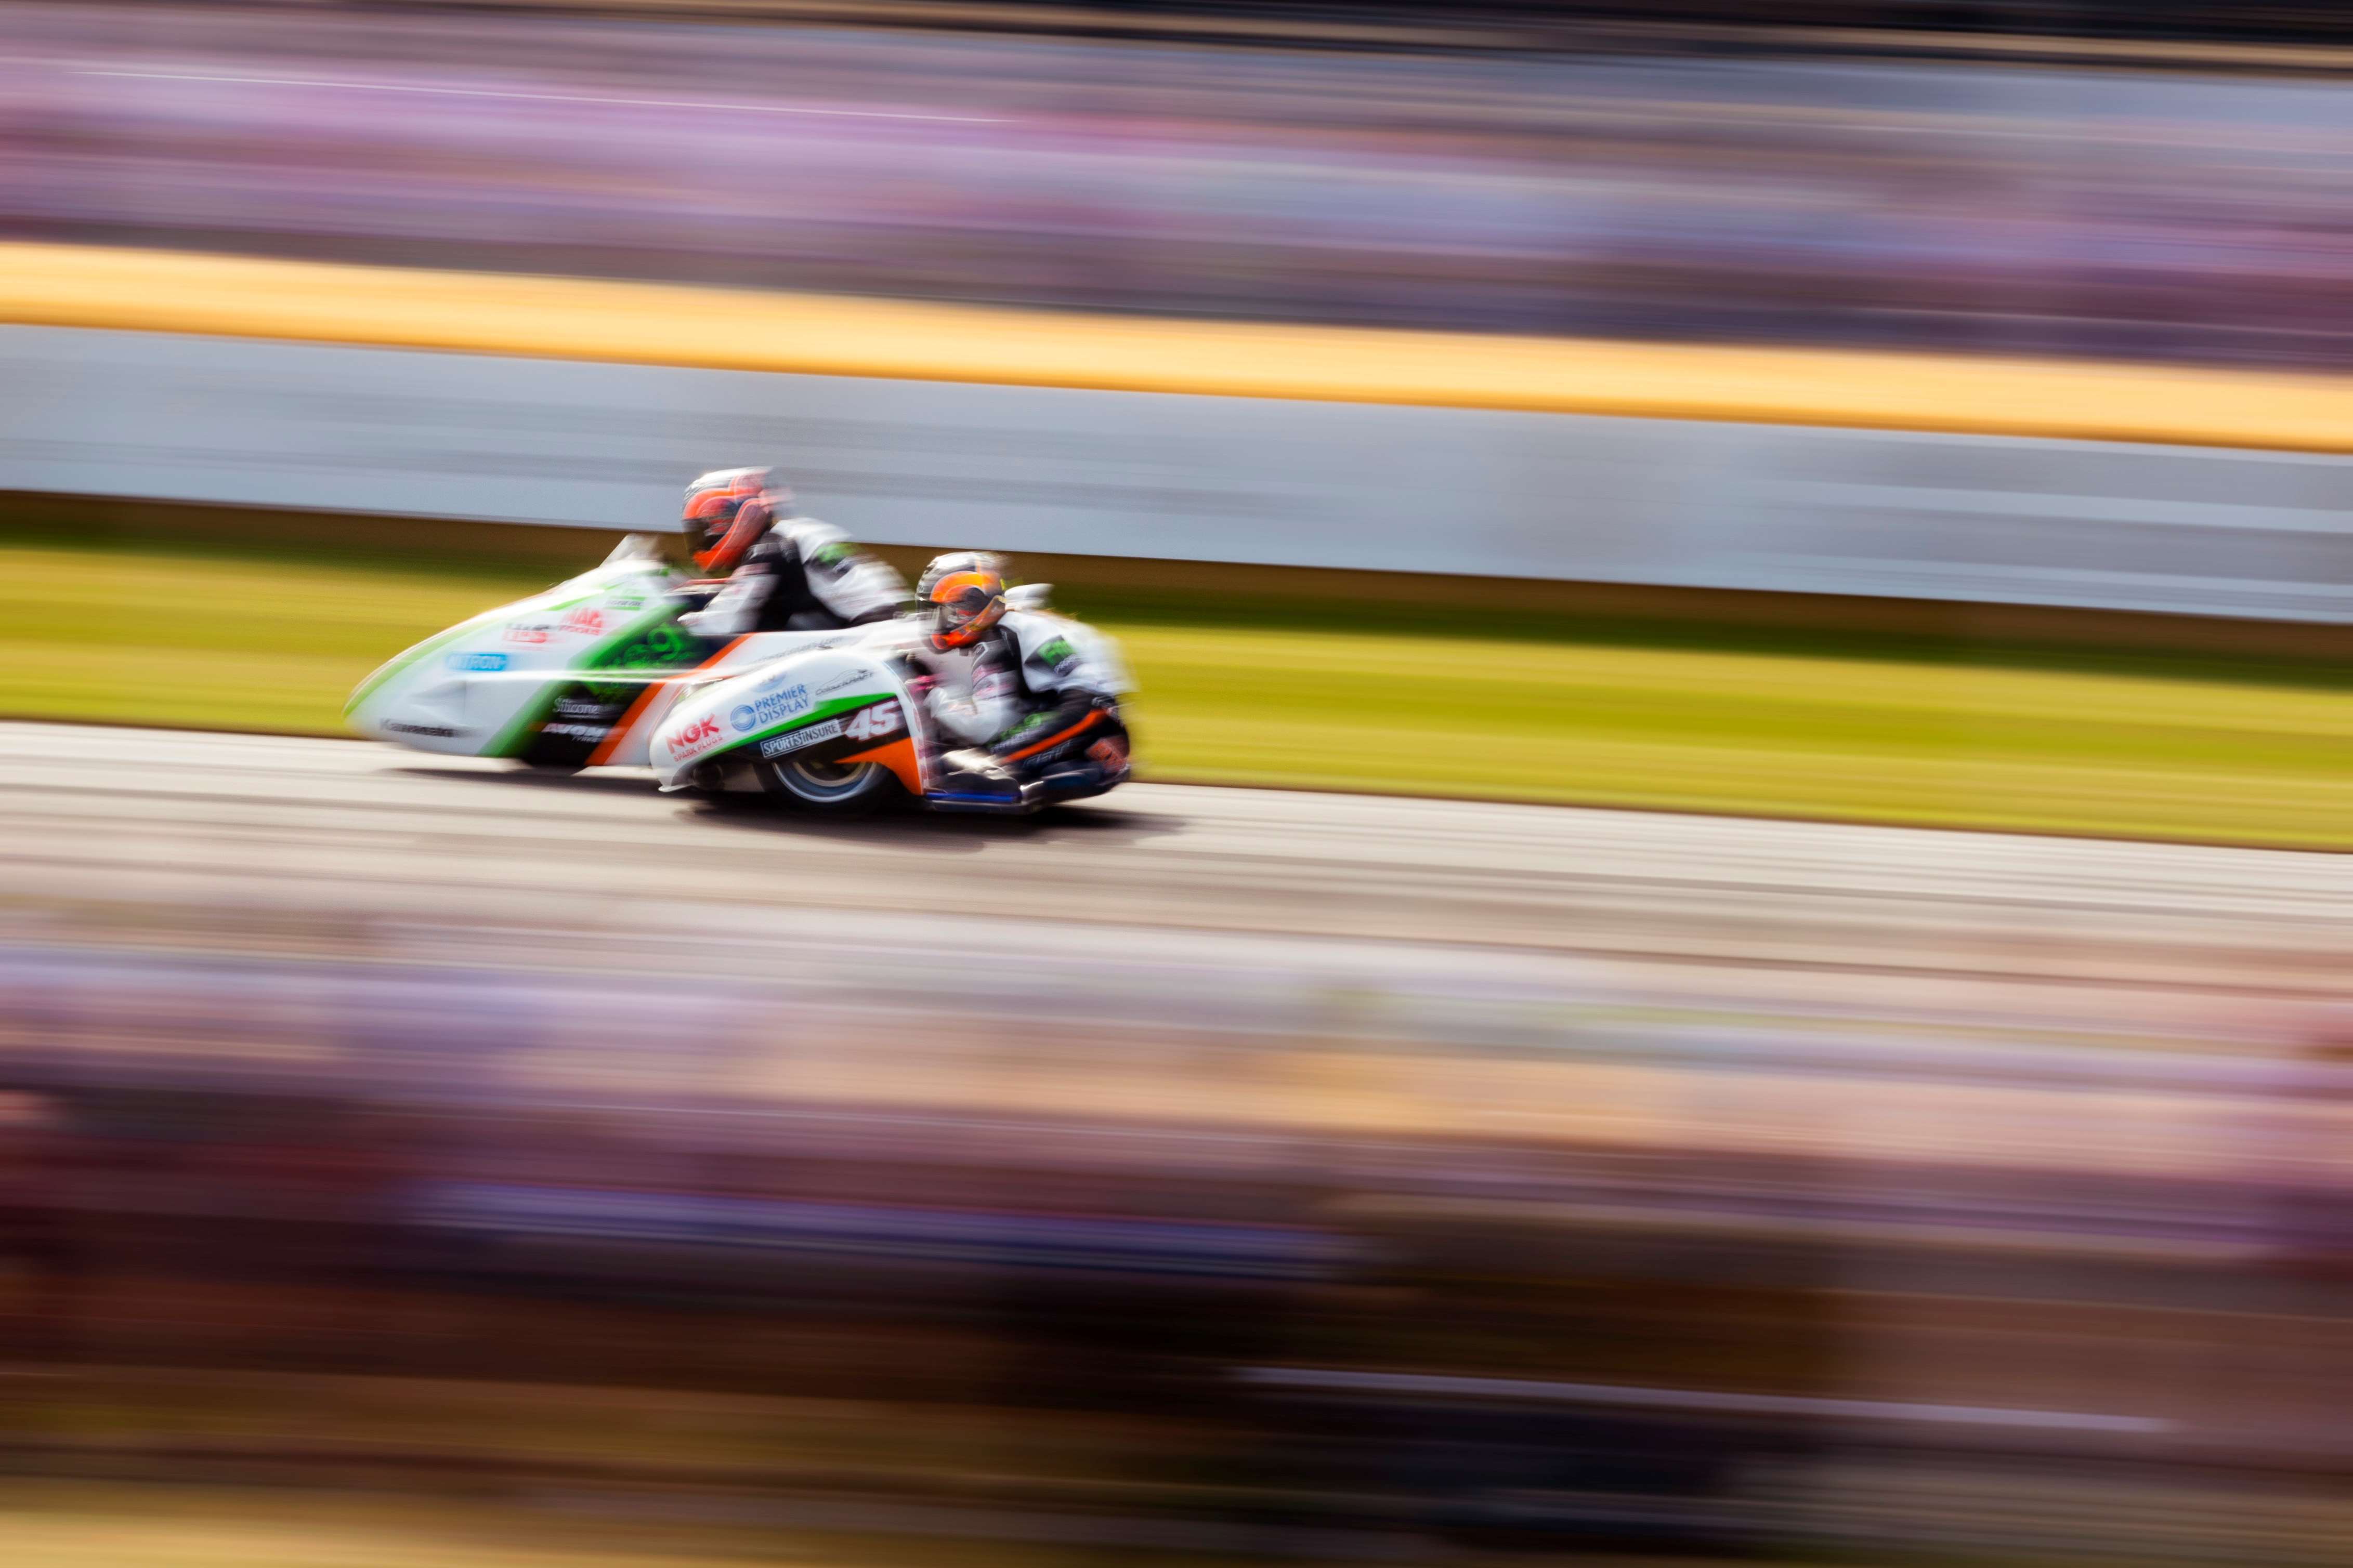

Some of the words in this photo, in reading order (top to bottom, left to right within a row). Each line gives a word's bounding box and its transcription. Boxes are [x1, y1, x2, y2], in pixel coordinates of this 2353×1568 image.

[754, 683, 806, 711] PREMIER
[759, 697, 809, 724] DISPLAY
[665, 713, 720, 754] NGK
[844, 700, 901, 741] 45
[673, 747, 697, 762] SPARK
[697, 734, 723, 752] PLUGS
